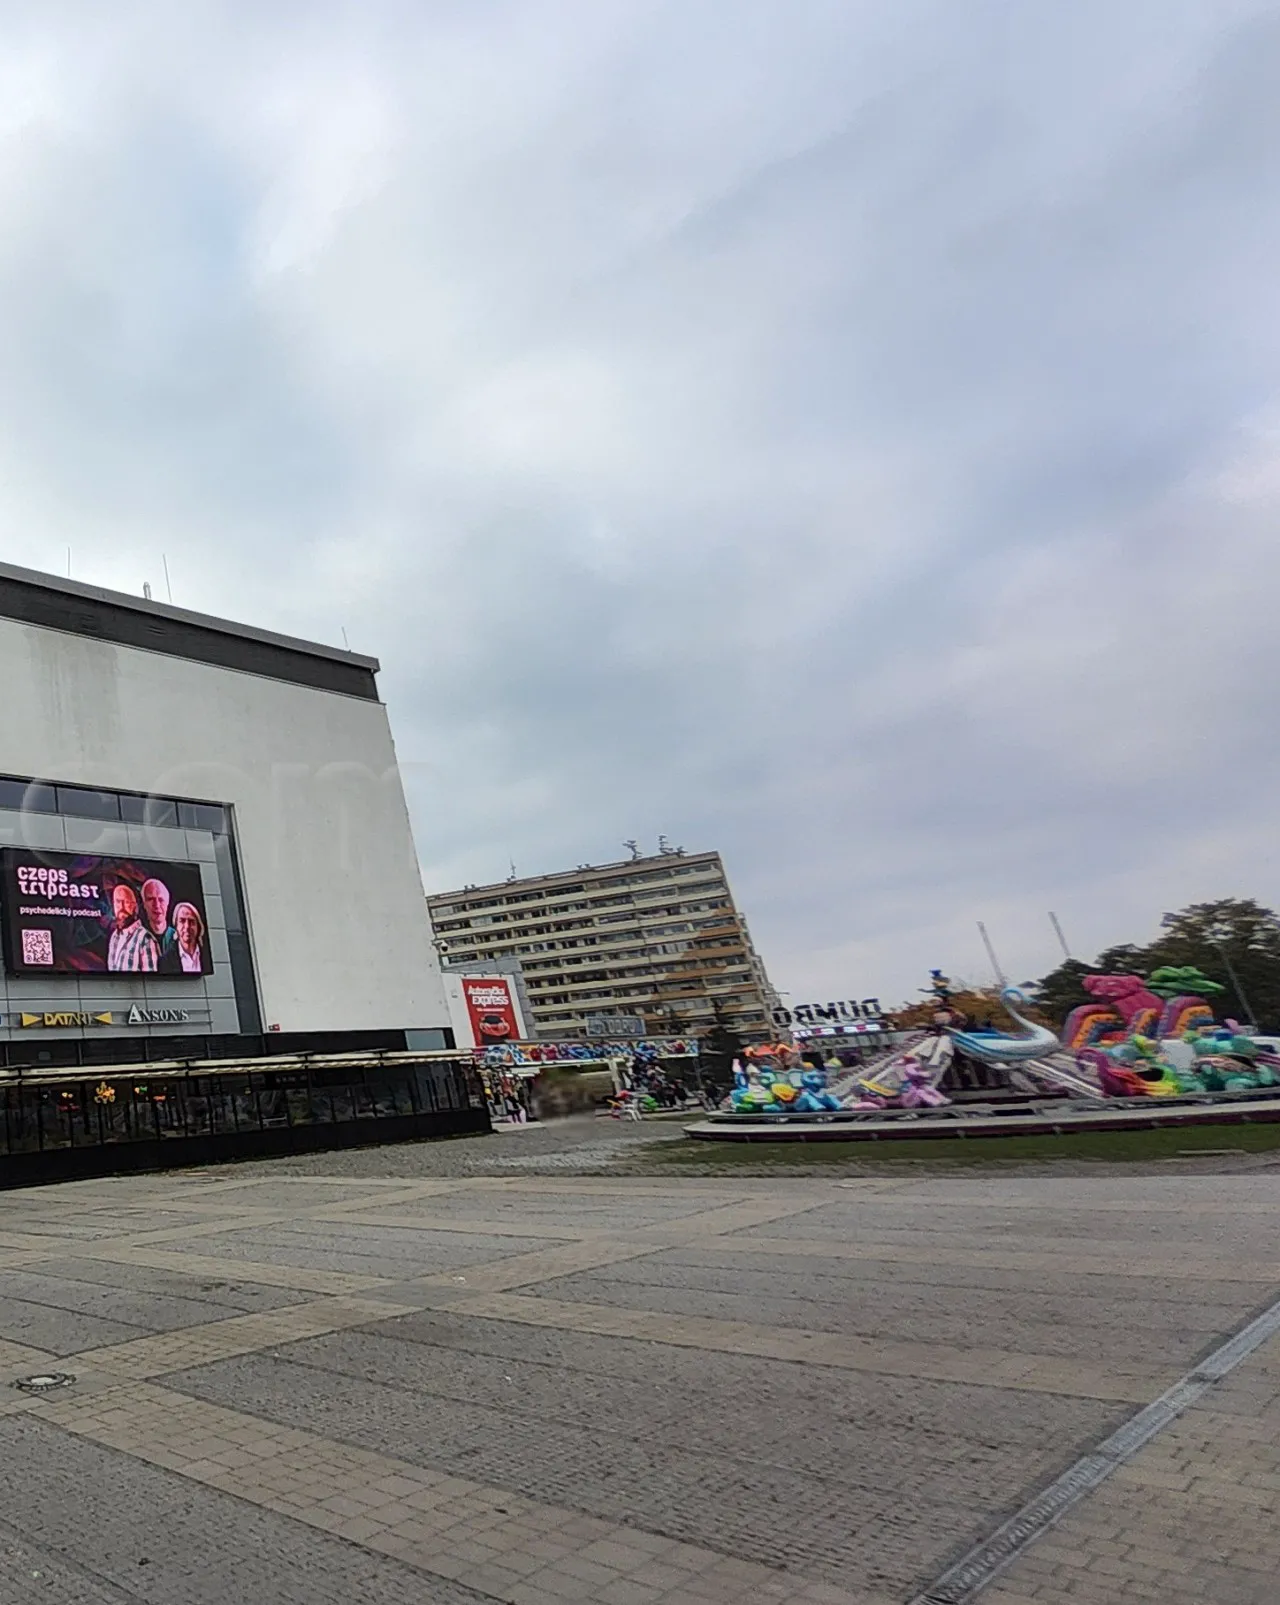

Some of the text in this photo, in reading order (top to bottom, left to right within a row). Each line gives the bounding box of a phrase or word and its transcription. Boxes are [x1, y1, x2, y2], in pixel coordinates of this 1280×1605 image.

[17, 866, 68, 883] czeps
[18, 880, 99, 900] tripcast
[19, 906, 101, 917] psychedelický podcast
[44, 1013, 94, 1026] DATART
